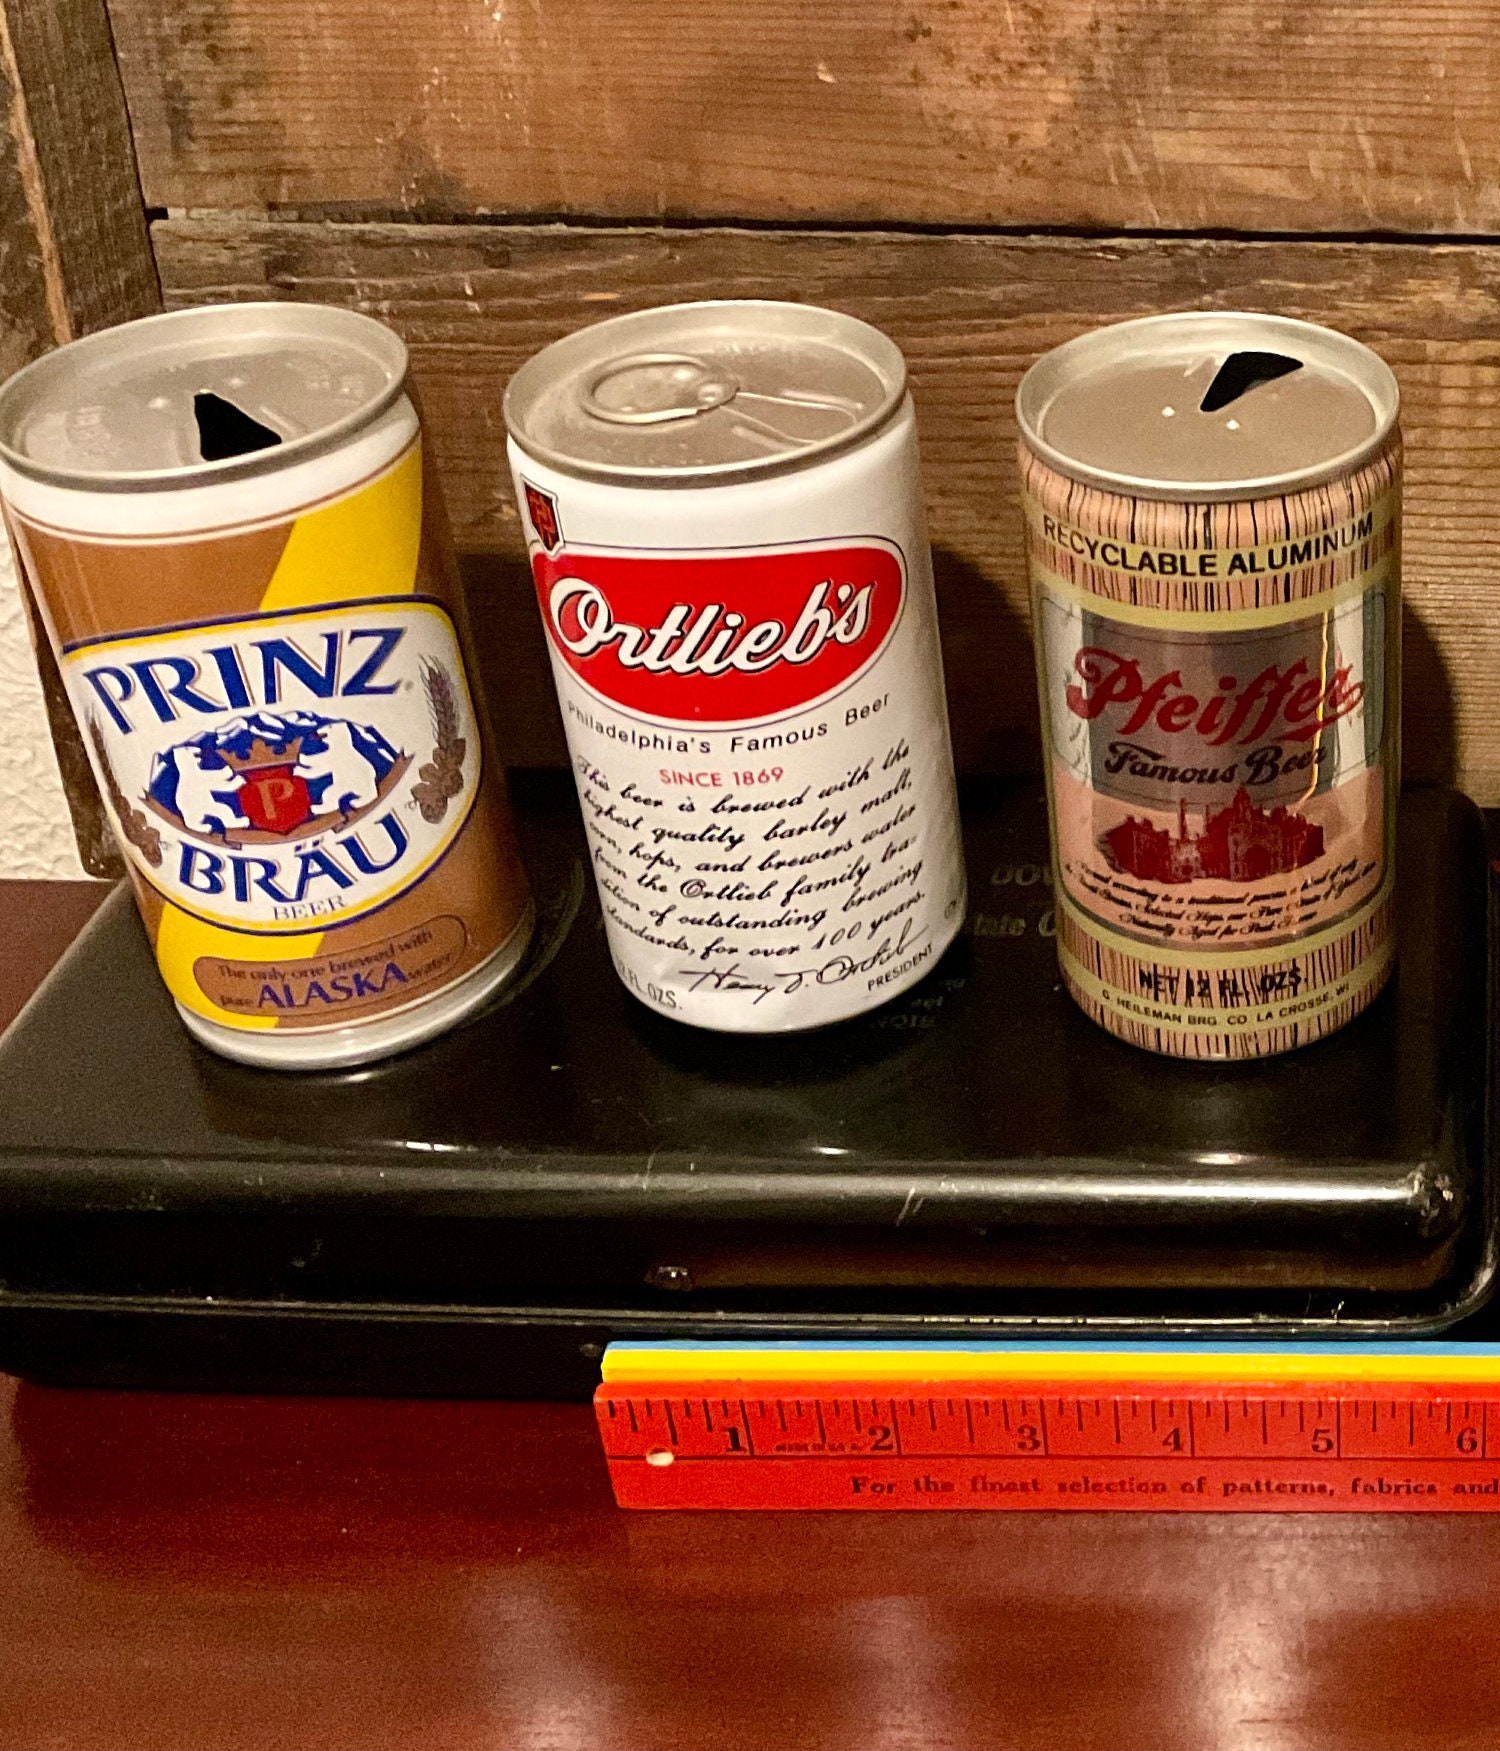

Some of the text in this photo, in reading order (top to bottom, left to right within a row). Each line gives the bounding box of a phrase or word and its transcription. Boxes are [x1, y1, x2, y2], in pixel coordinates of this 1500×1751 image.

[1043, 512, 1374, 577] RECYCLABLE ALUMINUM
[549, 577, 877, 677] Ortlieb's
[83, 627, 407, 735] PRINZ
[1066, 647, 1365, 746] Pfeiffer
[568, 692, 890, 754] Philadelphia's Famous Beer
[577, 738, 910, 813] This beer is brewed with the
[659, 766, 785, 787] SINCE 1869
[1103, 741, 1329, 786] Famous Beer
[255, 777, 294, 817] P
[584, 768, 912, 852] highest quality barley malt,
[178, 810, 413, 904] BRÄU
[629, 842, 681, 872] hops,
[695, 855, 751, 872] and
[758, 839, 853, 871] brewers
[861, 804, 915, 844] water
[273, 896, 346, 920] BEER
[637, 873, 667, 892] the
[679, 878, 778, 901] Ortlieb
[781, 855, 872, 907] family
[649, 904, 676, 927] of
[678, 908, 828, 931] outstanding
[841, 860, 924, 912] brewing
[700, 936, 738, 960] for
[749, 944, 800, 957] over
[811, 921, 862, 950] 100
[867, 890, 926, 941] years.
[250, 966, 286, 981] only
[329, 942, 395, 971] brewed
[399, 929, 433, 951] with
[868, 942, 934, 991] PRESIDENT
[258, 961, 409, 1008] ALASKA
[1117, 998, 1182, 1024] HEILEMAN
[1187, 1015, 1217, 1026] BRG
[1257, 1010, 1273, 1023] LA
[724, 1427, 747, 1453] 1
[868, 1425, 894, 1452] 2
[1017, 1425, 1041, 1452] 3
[1162, 1427, 1183, 1452] 4
[1310, 1428, 1334, 1455] 5
[1456, 1427, 1479, 1455] 6
[851, 1476, 897, 1495] For
[914, 1475, 955, 1494] the
[970, 1475, 1041, 1494] finest
[1056, 1476, 1168, 1495] selection
[1180, 1476, 1208, 1495] of
[1222, 1478, 1336, 1497] patterns,
[1350, 1477, 1438, 1495] fabrics
[1453, 1477, 1499, 1495] and
